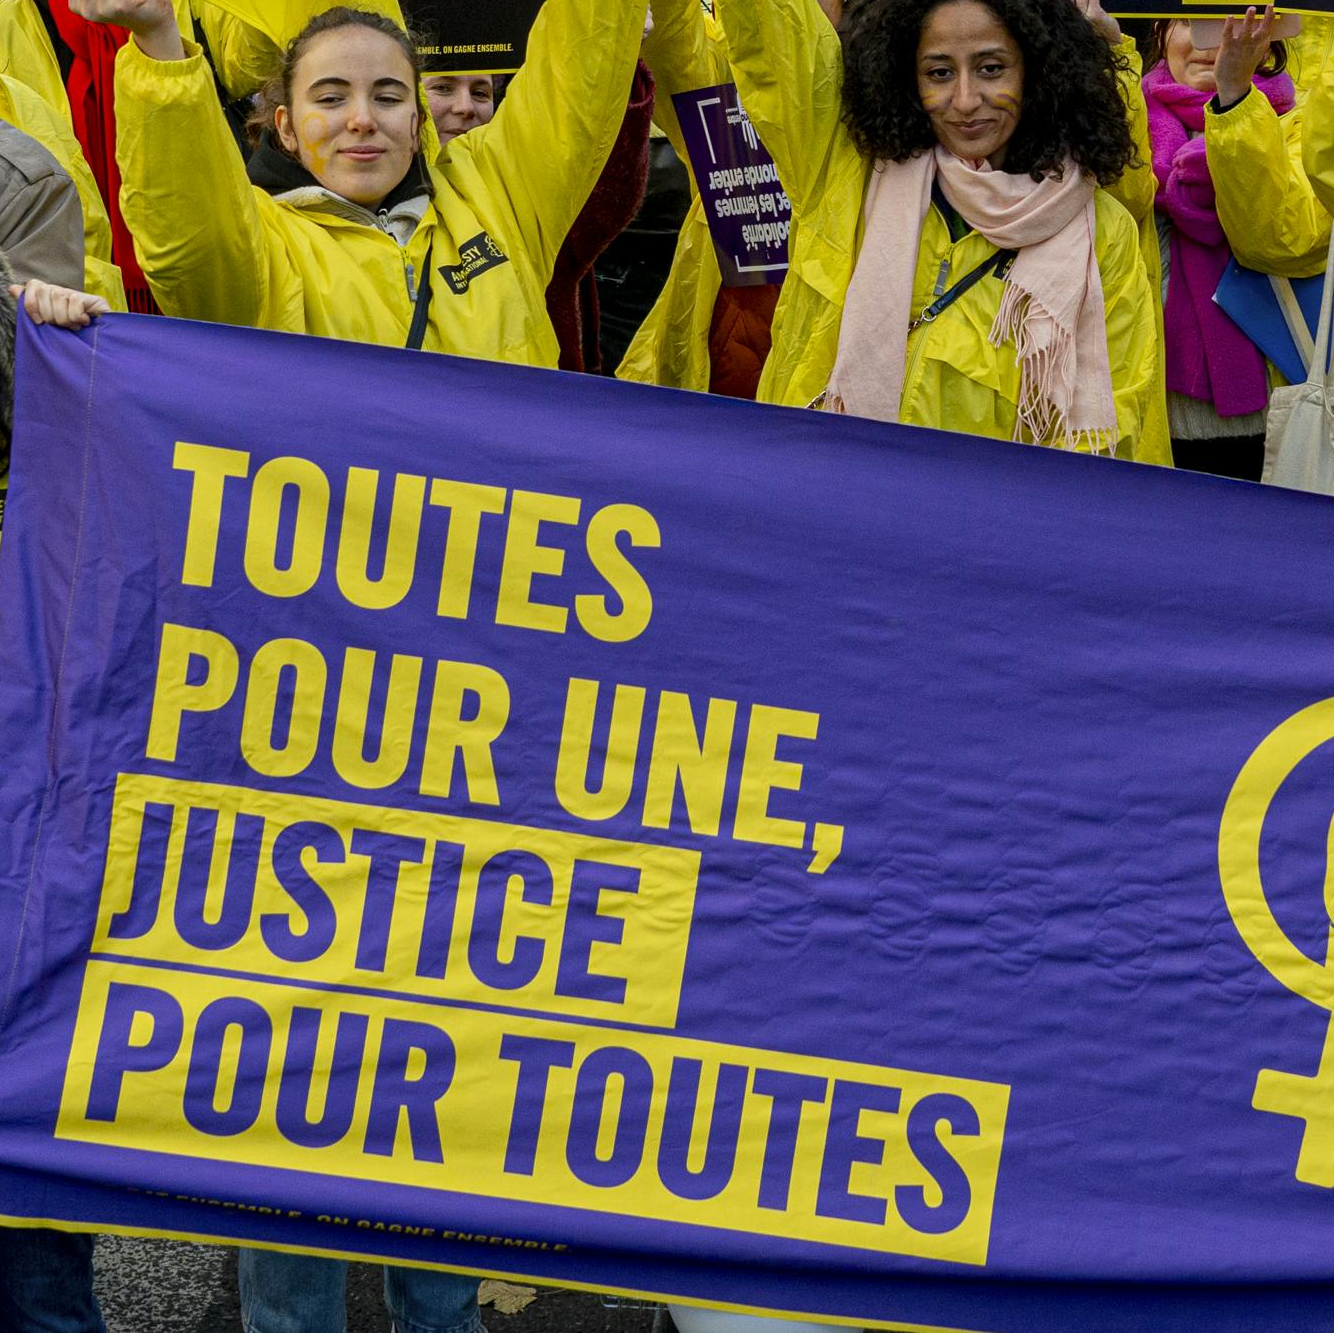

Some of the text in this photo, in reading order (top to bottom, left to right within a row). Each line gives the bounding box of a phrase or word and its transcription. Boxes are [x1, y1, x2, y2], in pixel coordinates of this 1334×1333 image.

[714, 196, 760, 222] femmes
[171, 442, 662, 644] TOUTES
[145, 622, 845, 875] POUR UNE,
[108, 802, 642, 1004] JUSTICE
[85, 981, 980, 1237] POUR TOUTES
